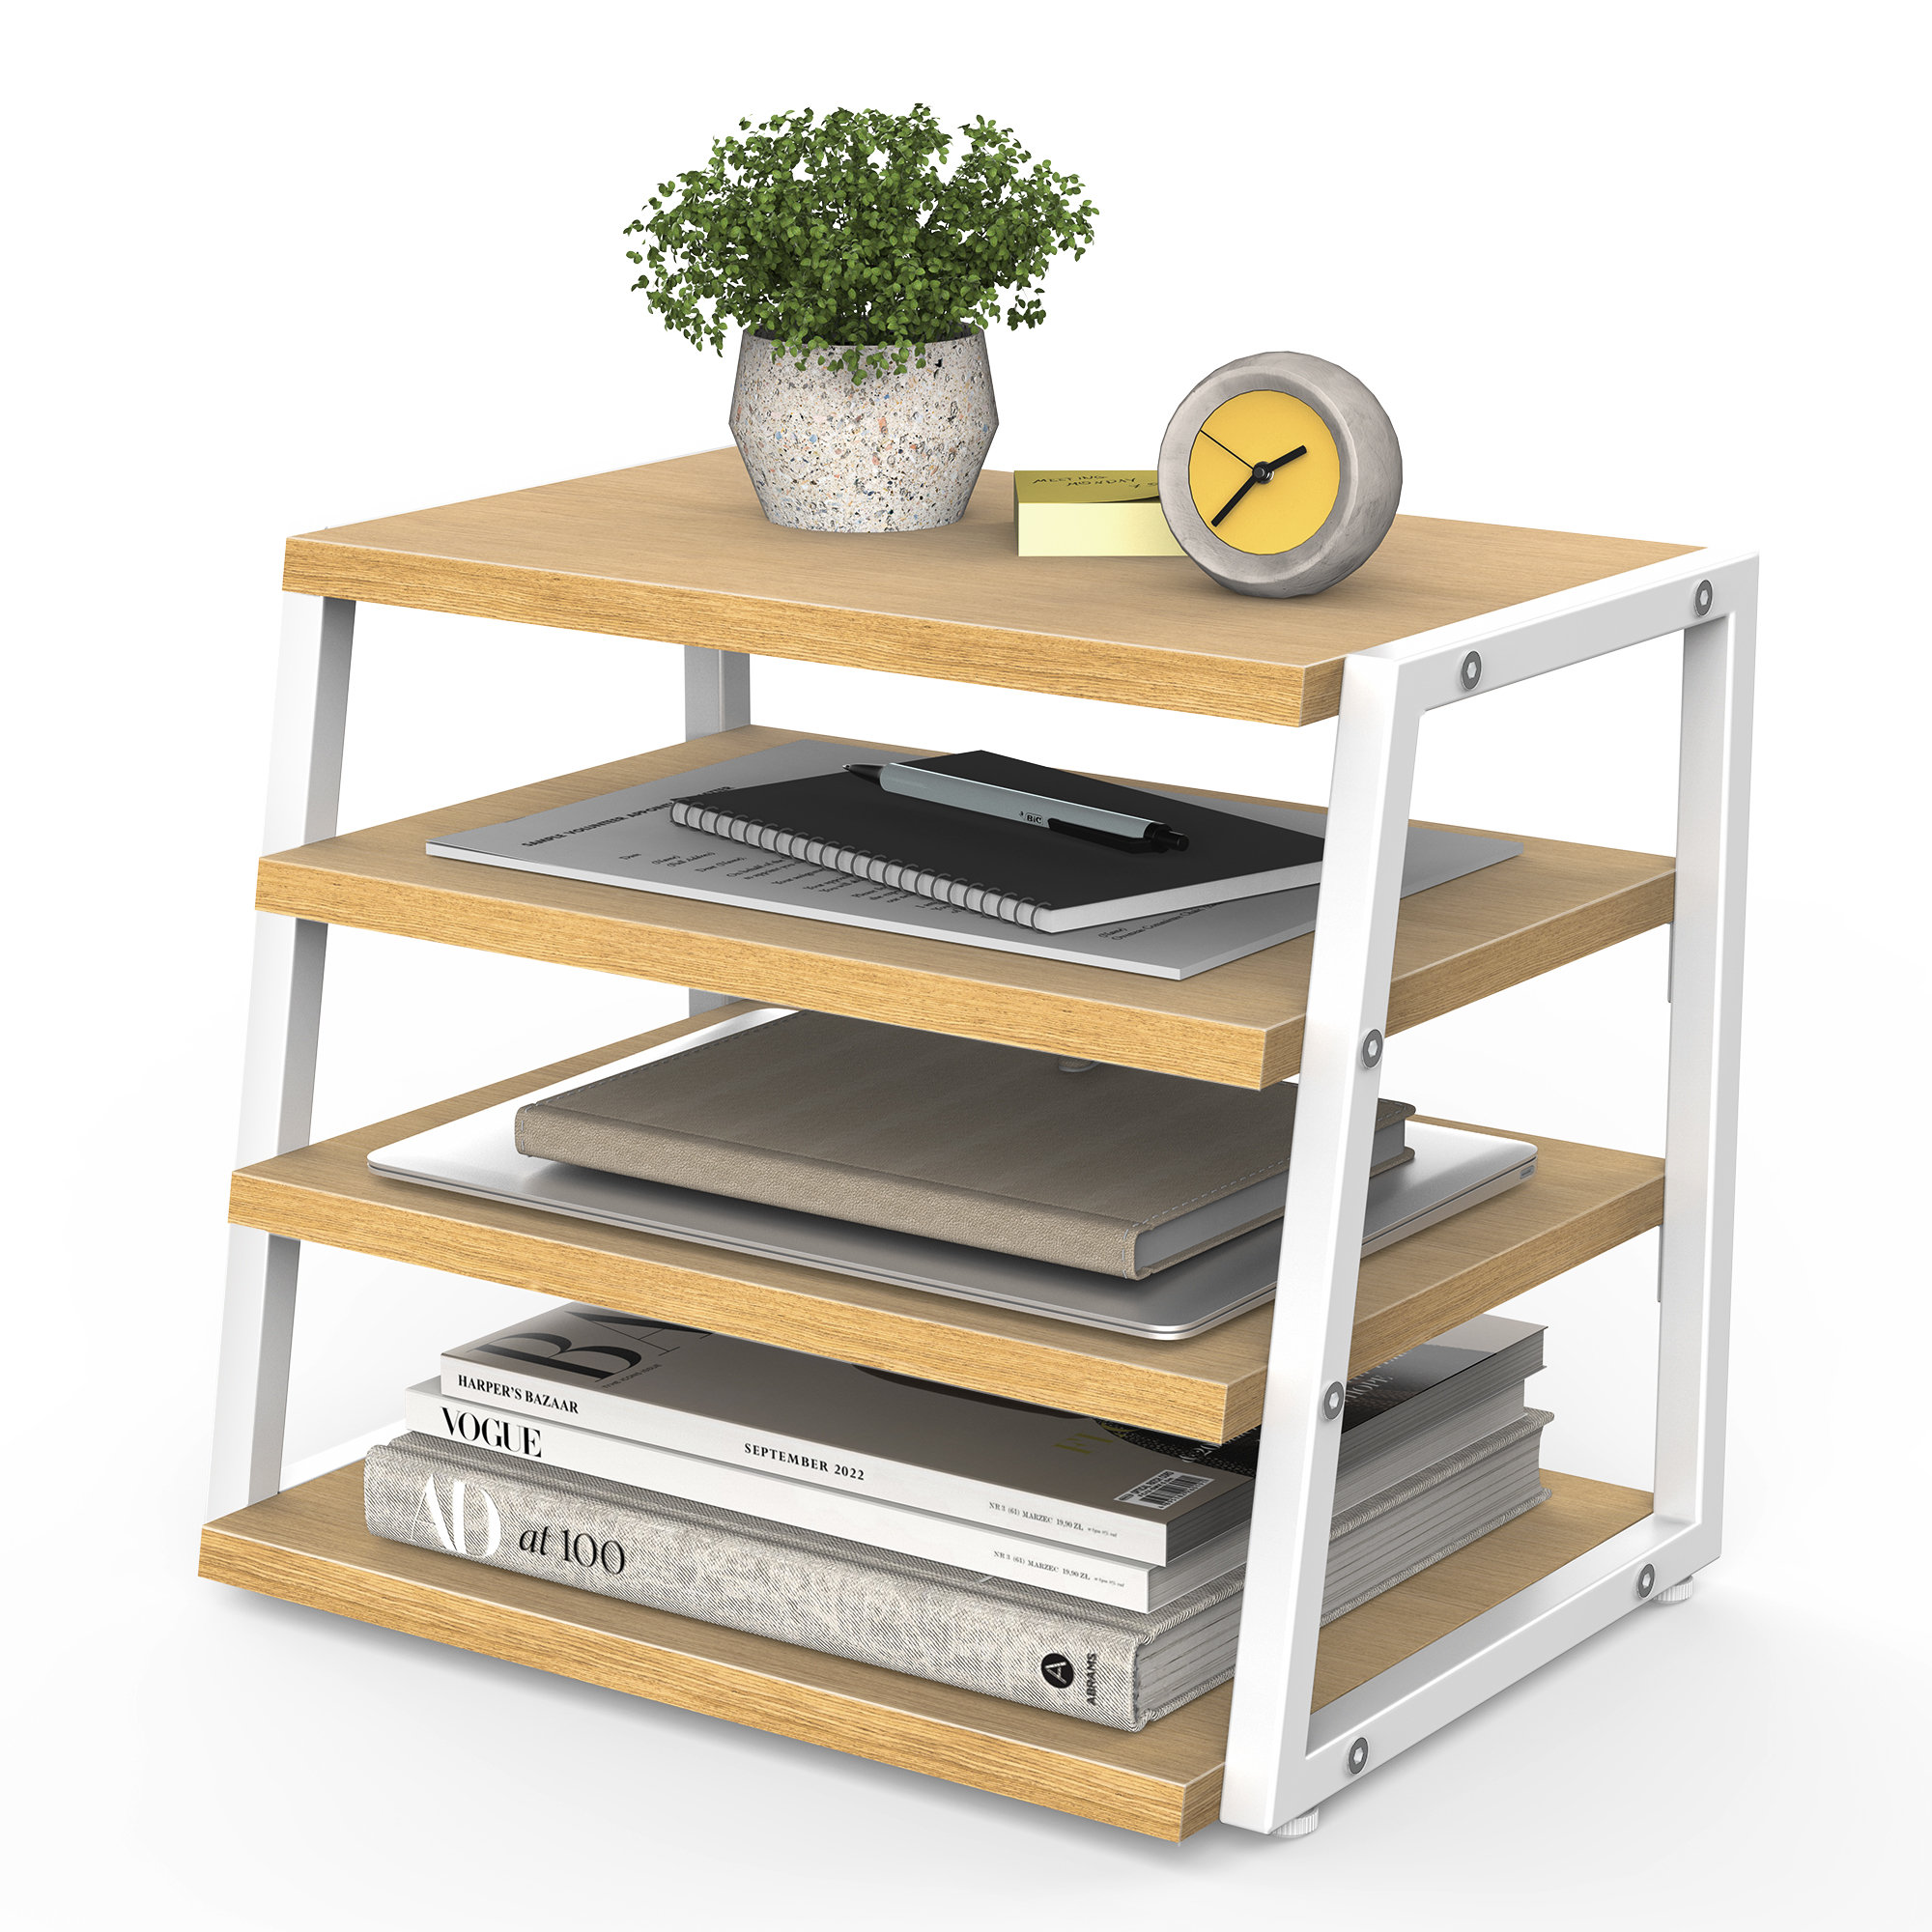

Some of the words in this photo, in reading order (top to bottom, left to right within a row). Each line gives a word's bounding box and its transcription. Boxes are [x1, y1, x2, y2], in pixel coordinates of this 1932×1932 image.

[522, 833, 567, 847] SAMPLE
[565, 816, 629, 835] VOLUNTEER
[458, 1374, 523, 1401] HARPER’S
[525, 1389, 579, 1414] BAZAAR
[440, 1406, 542, 1459] VOGUE
[744, 1442, 829, 1472] SEPTEMBER
[835, 1463, 865, 1481] 2022
[411, 1473, 500, 1558] AD
[519, 1526, 552, 1556] at
[562, 1529, 626, 1576] 100
[989, 1501, 1001, 1511] NR
[1008, 1506, 1020, 1517] (61)
[1022, 1509, 1053, 1523] MARZEC
[993, 1550, 1005, 1560] NR
[1013, 1554, 1026, 1566] (61)
[1027, 1558, 1060, 1574] MARZEC
[1086, 1652, 1097, 1707] ABRAMS
